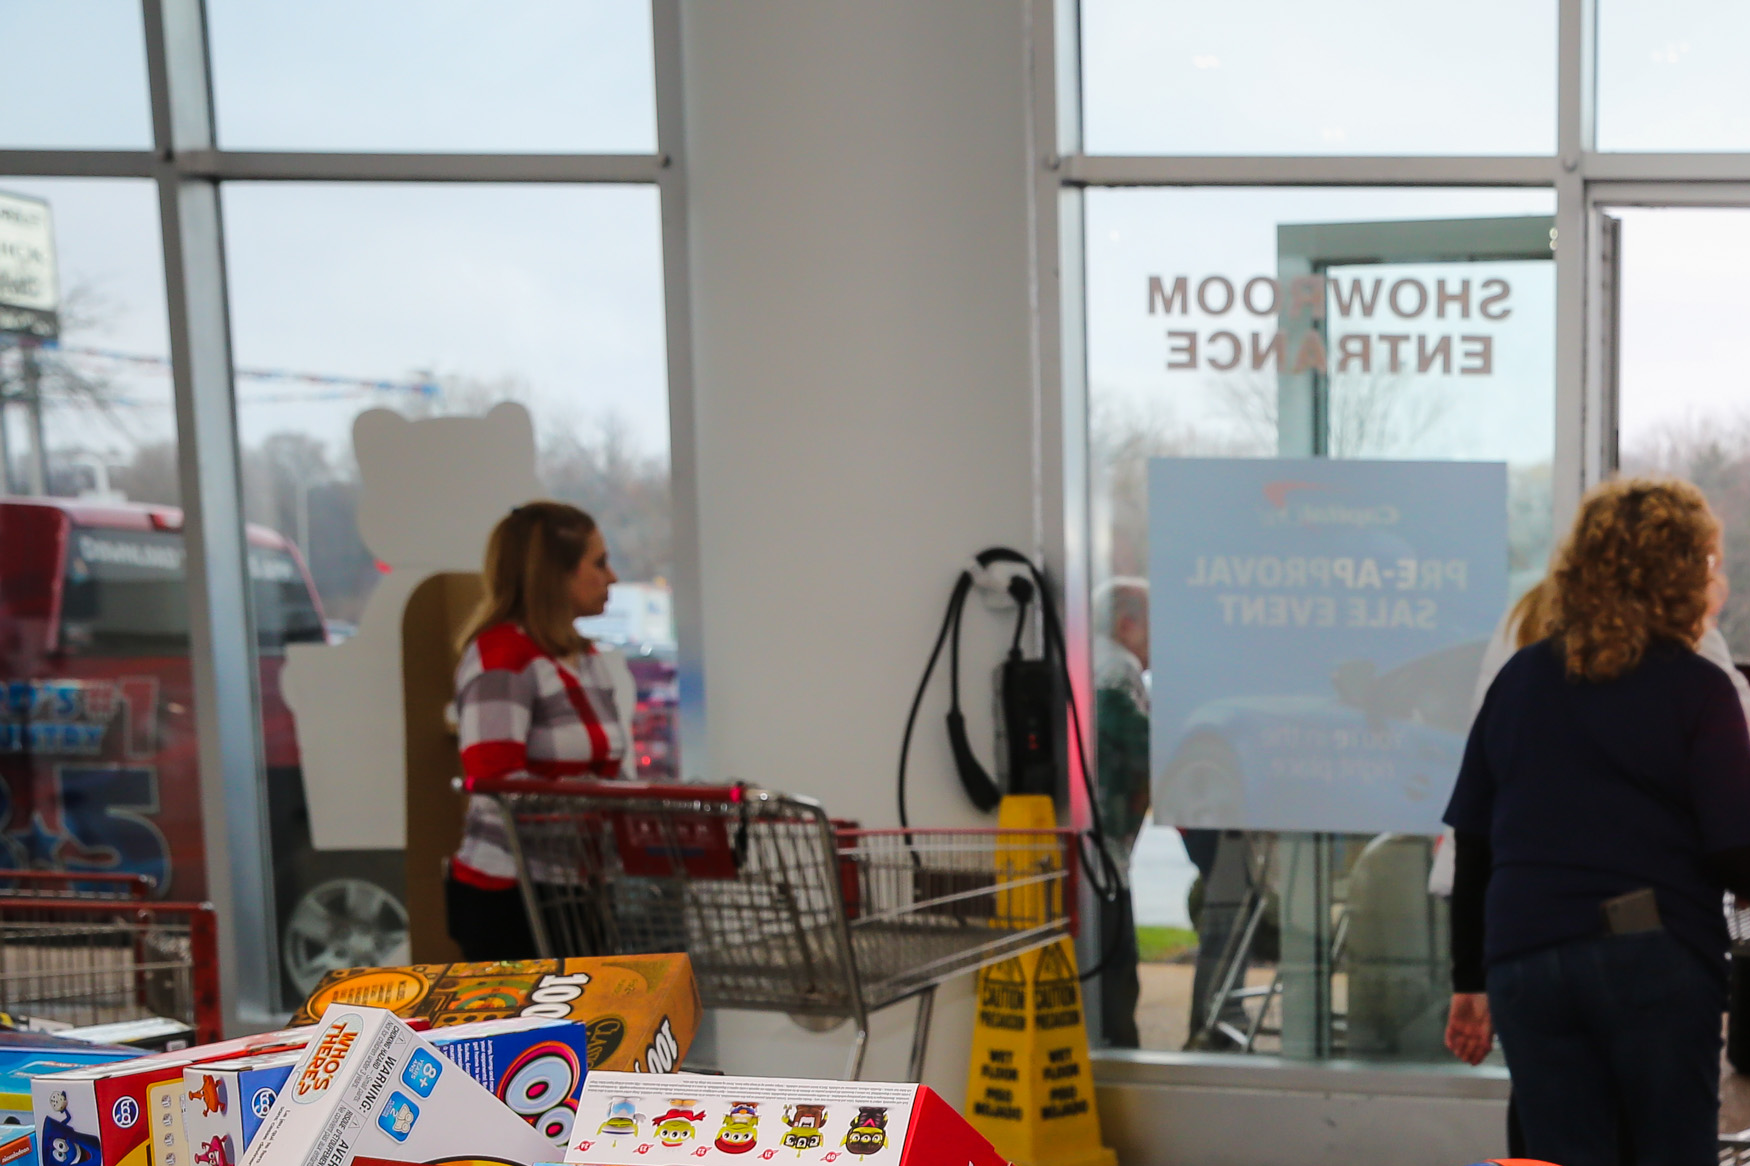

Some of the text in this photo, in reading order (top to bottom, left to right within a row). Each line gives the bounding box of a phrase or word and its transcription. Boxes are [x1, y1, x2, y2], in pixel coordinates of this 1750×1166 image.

[297, 1022, 347, 1096] THERE?
[314, 1032, 358, 1091] WHO'S
[359, 1057, 397, 1114] WARNING:
